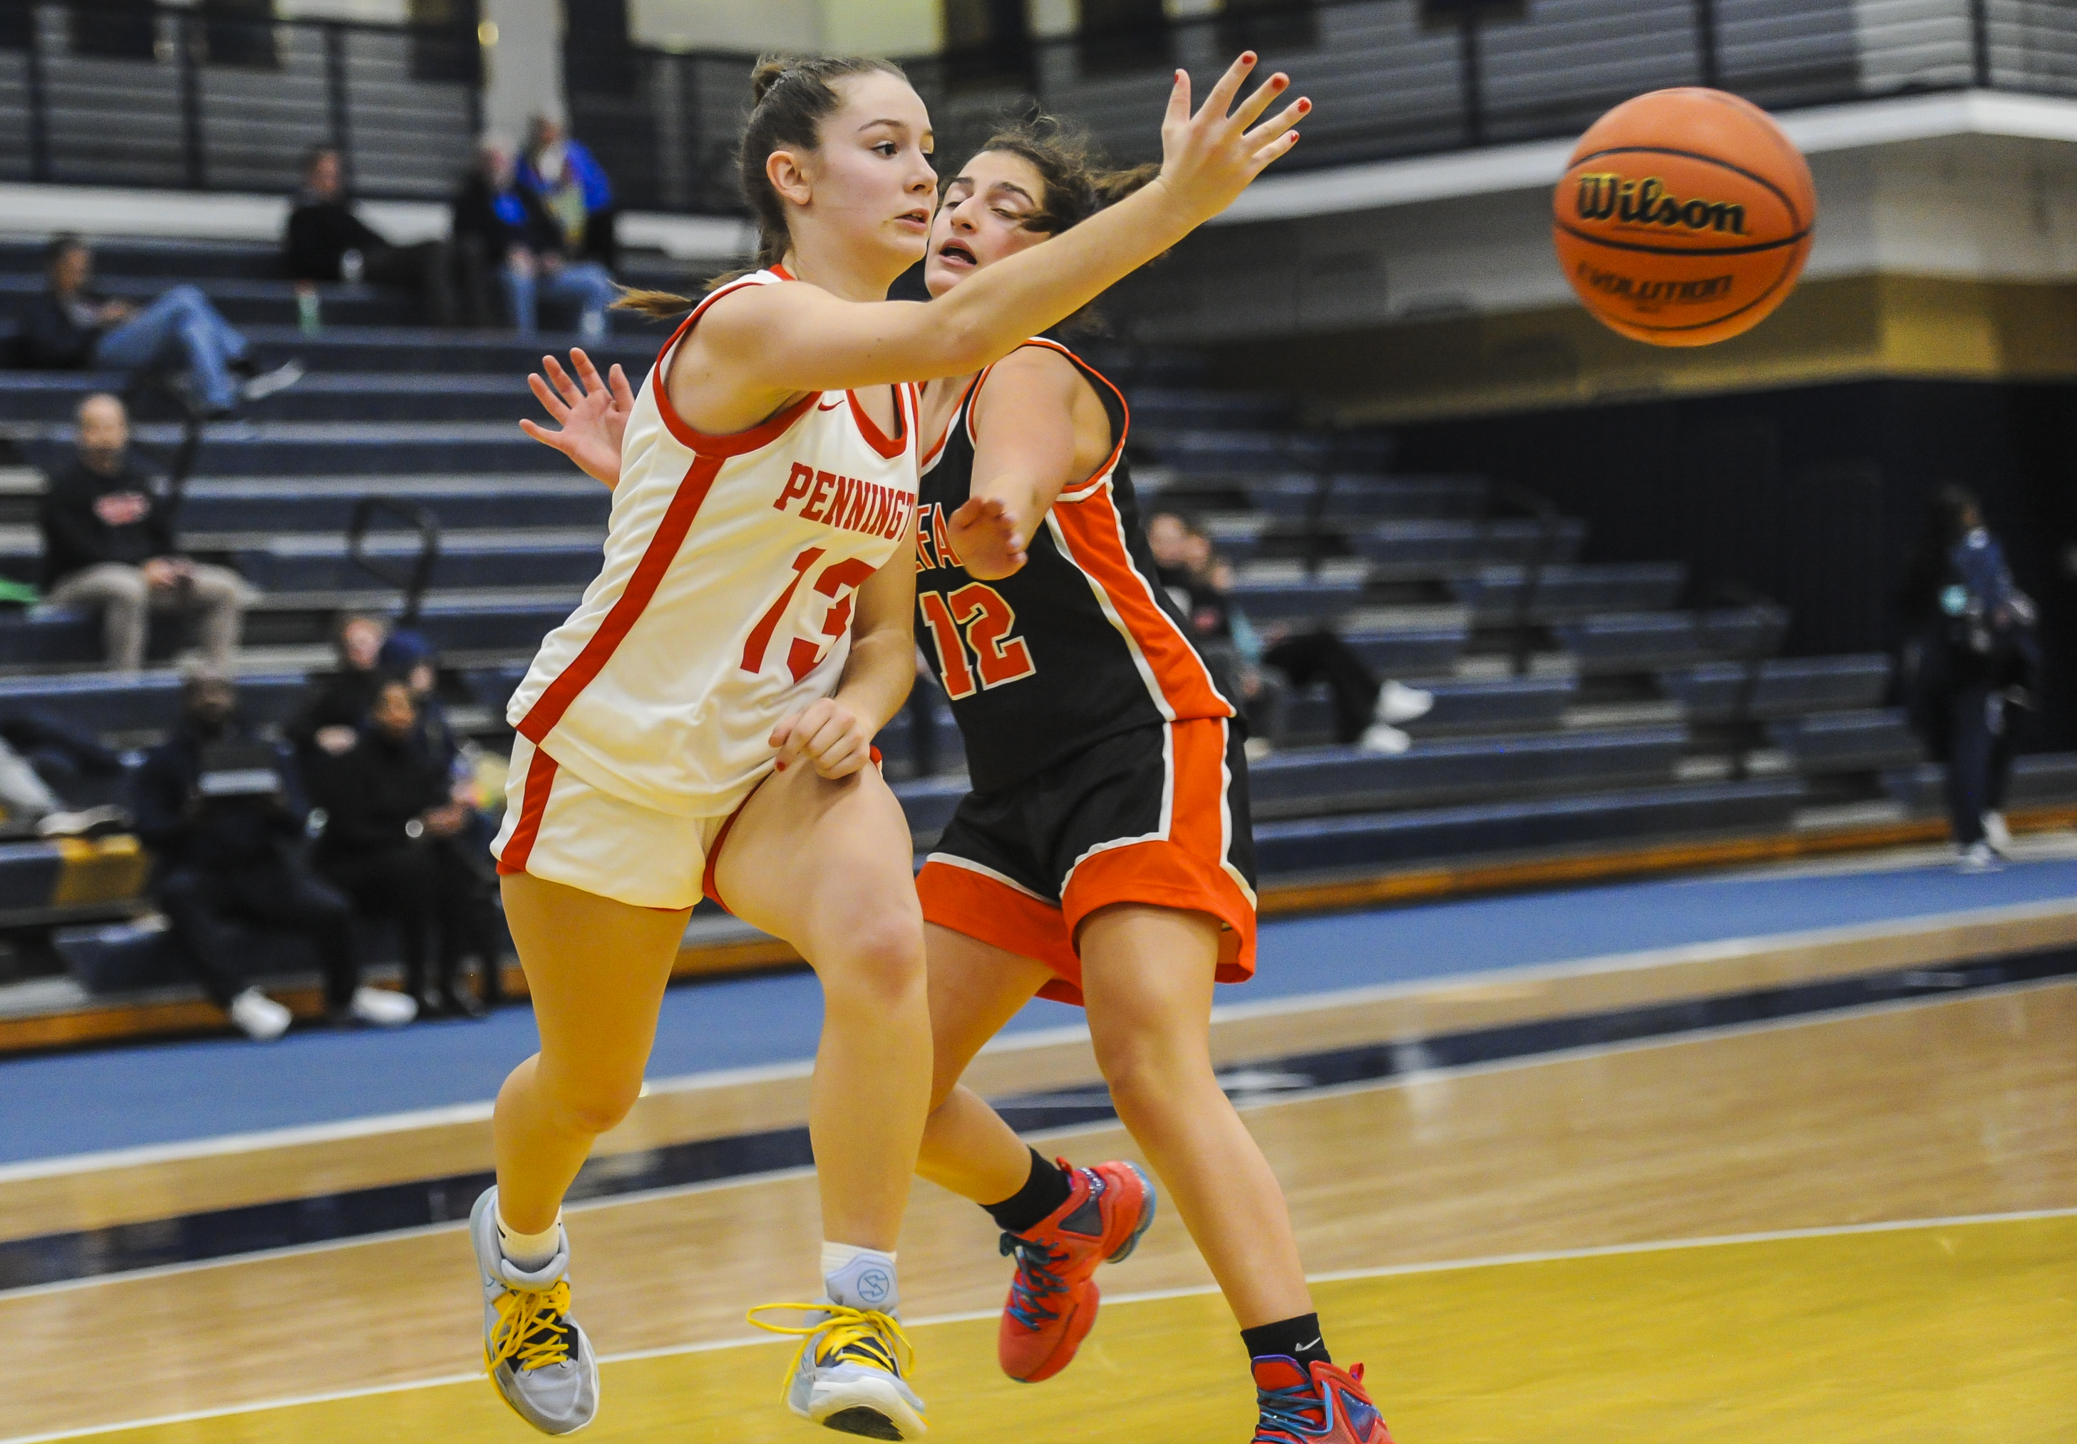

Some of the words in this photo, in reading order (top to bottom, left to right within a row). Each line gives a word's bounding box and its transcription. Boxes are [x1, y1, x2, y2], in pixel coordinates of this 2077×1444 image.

[1576, 173, 1748, 235] Wilson
[739, 546, 878, 685] 13
[918, 581, 1037, 701] 12
